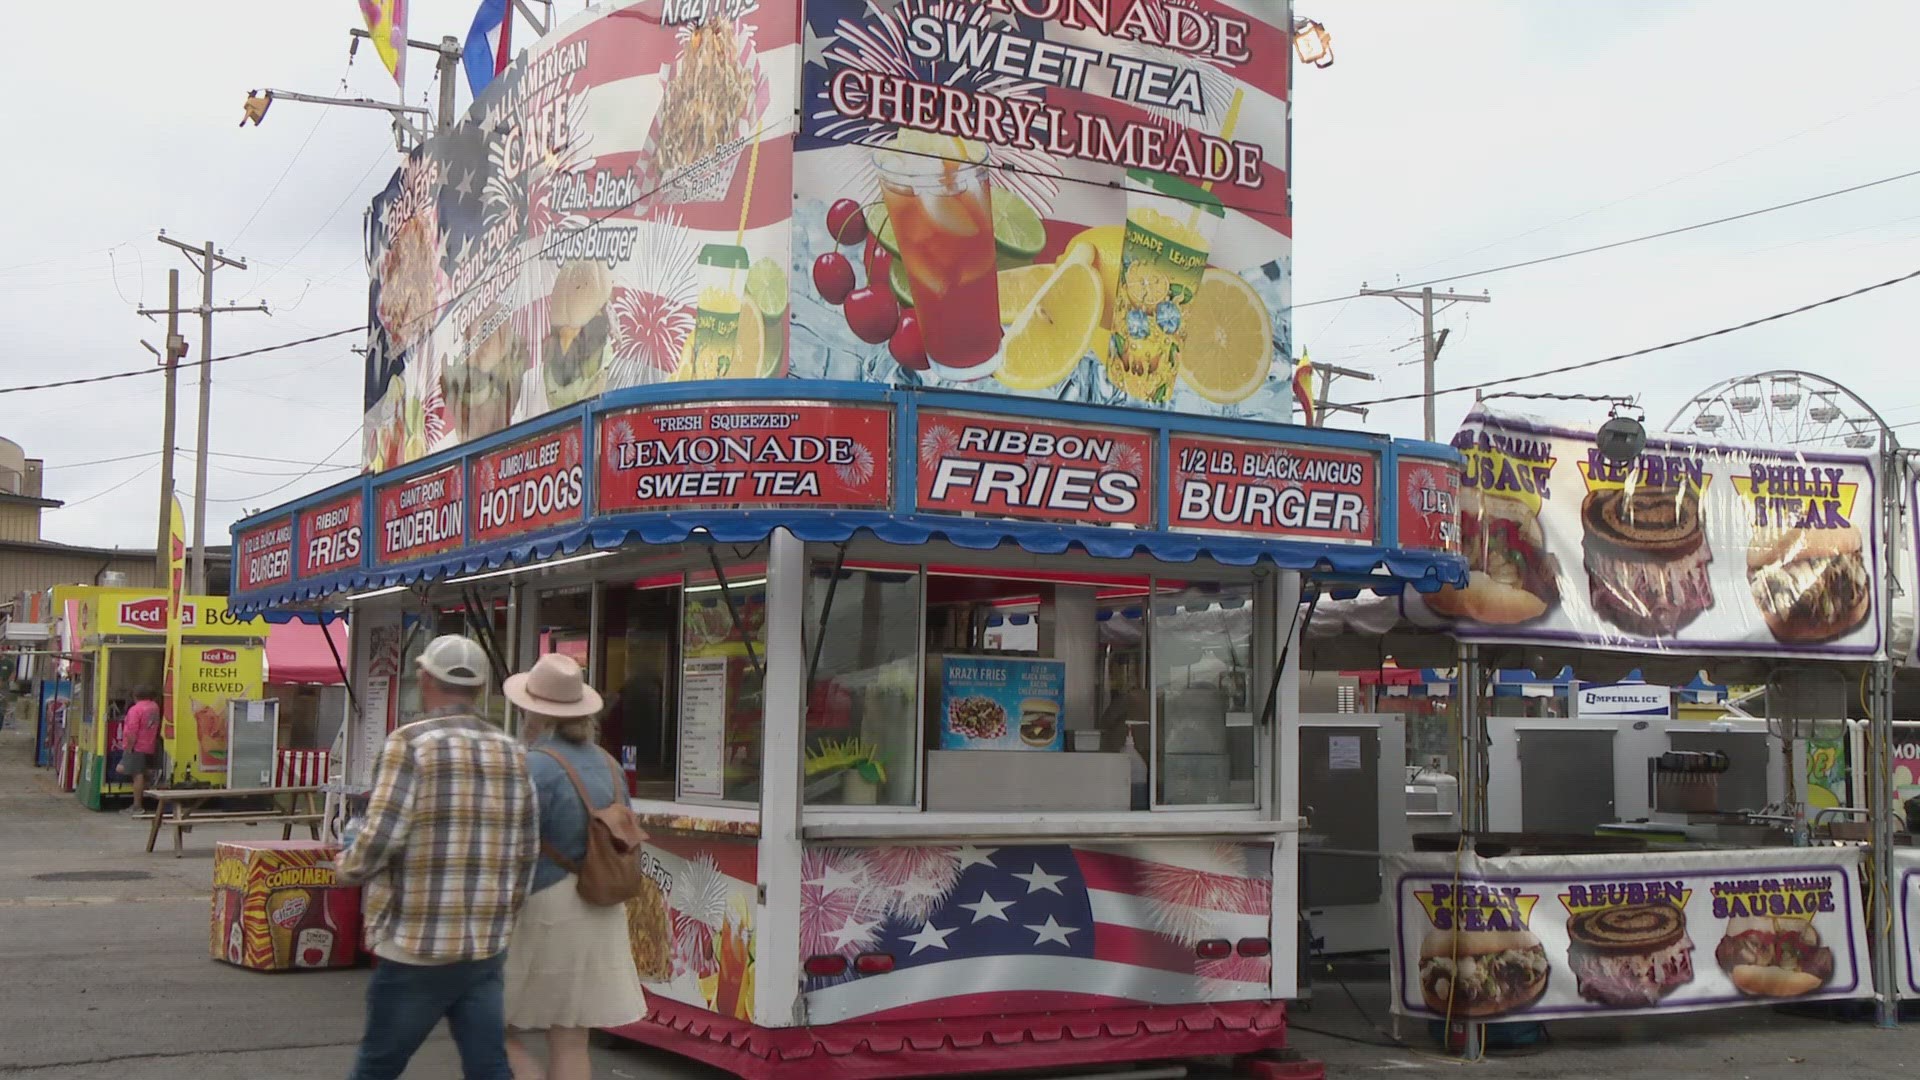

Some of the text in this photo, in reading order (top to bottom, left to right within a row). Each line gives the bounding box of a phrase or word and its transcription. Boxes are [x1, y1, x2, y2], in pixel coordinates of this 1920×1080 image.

[493, 40, 588, 126] ALL AMERICAN
[905, 15, 1204, 116] SWEET TEA
[504, 92, 568, 179] CAFE
[830, 68, 1264, 189] CHERRY LIMEADE
[593, 168, 635, 208] Black
[541, 222, 638, 270] Angus Burger
[452, 249, 521, 345] Tenderloin
[498, 440, 561, 480] JUMBO ALL BEEF
[617, 436, 855, 470] LEMONADE
[958, 426, 1114, 463] RIBBON
[636, 471, 820, 499] SWEET TEA
[929, 456, 1140, 514] FRIES
[1180, 447, 1363, 486] 1/2 LB. BLACK ANGUS
[1461, 453, 1551, 500] USAGE
[1750, 463, 1845, 498] PHILLY
[400, 478, 445, 509] GIANT PORK
[479, 464, 583, 530] HOT DOGS
[1178, 480, 1364, 532] BURGER
[315, 506, 349, 531] RIBBON
[385, 500, 463, 553] TENDERLOIN
[1755, 496, 1852, 529] STEAK
[249, 548, 289, 584] BURGER
[307, 526, 362, 569] FRIES
[125, 606, 160, 622] Iced
[199, 668, 237, 678] FRESH
[203, 652, 235, 660] Iced Tea
[949, 666, 1007, 681] KRAZY FRIES
[192, 683, 243, 693] BREWED
[649, 857, 673, 892] Frys
[1568, 881, 1684, 907] REUBEN
[1713, 891, 1835, 918] SAUSAGE
